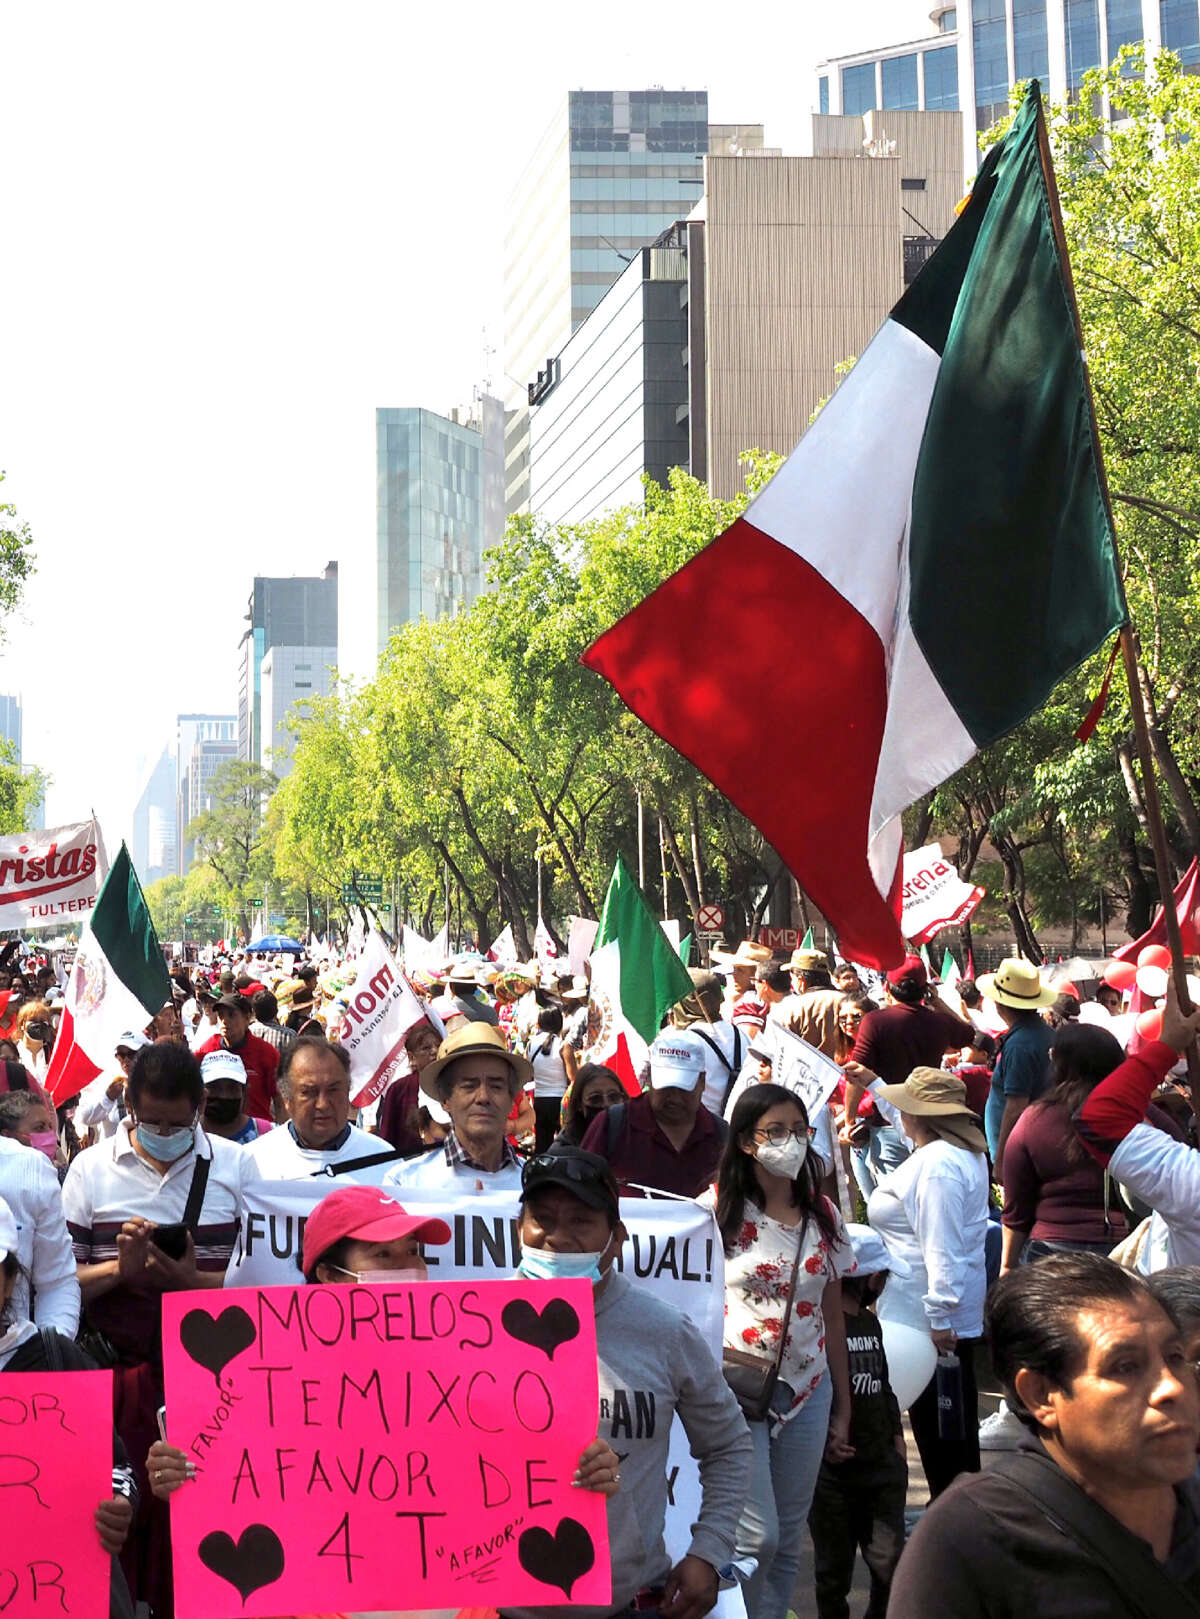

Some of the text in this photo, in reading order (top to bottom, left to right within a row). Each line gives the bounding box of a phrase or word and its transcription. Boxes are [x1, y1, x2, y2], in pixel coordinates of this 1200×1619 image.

[902, 861, 950, 898] orena
[29, 895, 96, 918] TULTEPE
[659, 1046, 691, 1059] morena
[257, 1287, 493, 1361] MORELOS
[846, 1336, 880, 1351] MOM'S
[248, 1365, 554, 1435] TEMIXCO
[478, 1453, 558, 1509] DE
[316, 1511, 448, 1583] 4 T
